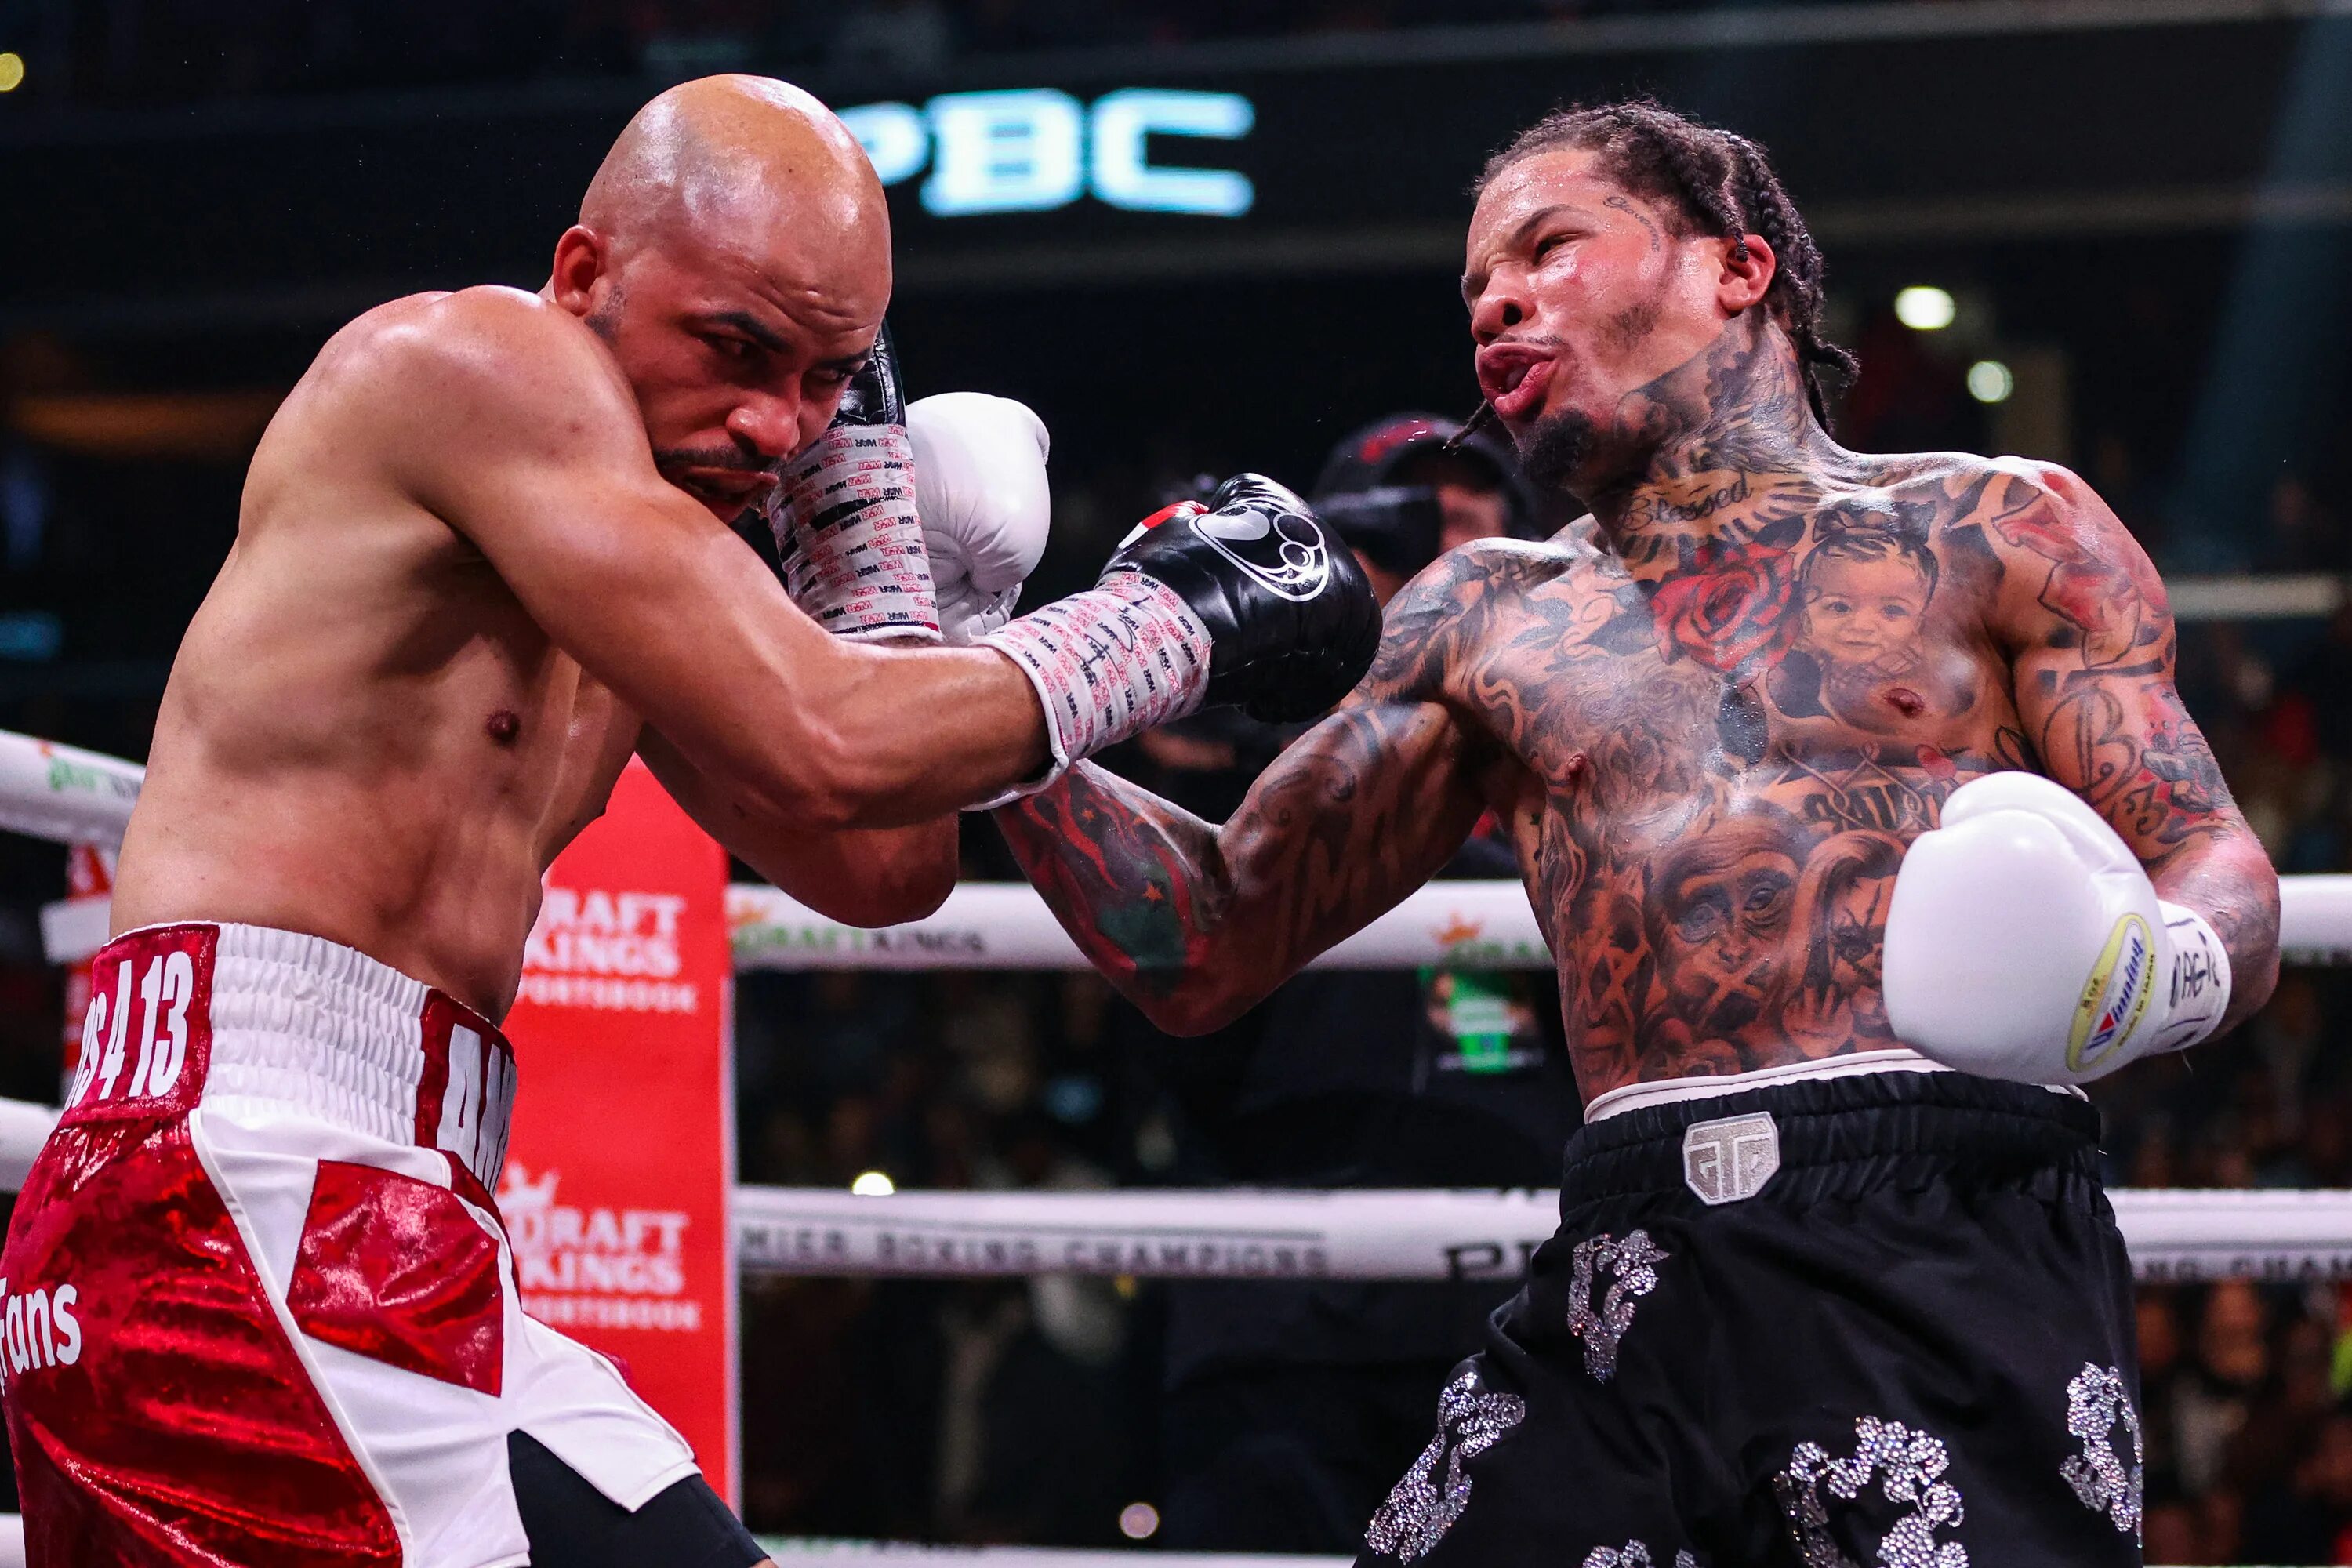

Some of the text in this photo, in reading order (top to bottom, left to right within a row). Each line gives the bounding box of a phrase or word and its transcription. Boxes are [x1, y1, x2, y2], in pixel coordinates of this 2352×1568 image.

[883, 487, 902, 496] WAR
[898, 516, 915, 524] WAR
[1140, 577, 1160, 591] WAR
[1178, 615, 1196, 636] WAR
[1038, 636, 1058, 654] WAR
[1024, 651, 1040, 670] WAR
[1143, 668, 1156, 693] WAR
[1066, 692, 1078, 718] WAR
[1125, 688, 1134, 713] WAR
[538, 887, 687, 935] RAFT
